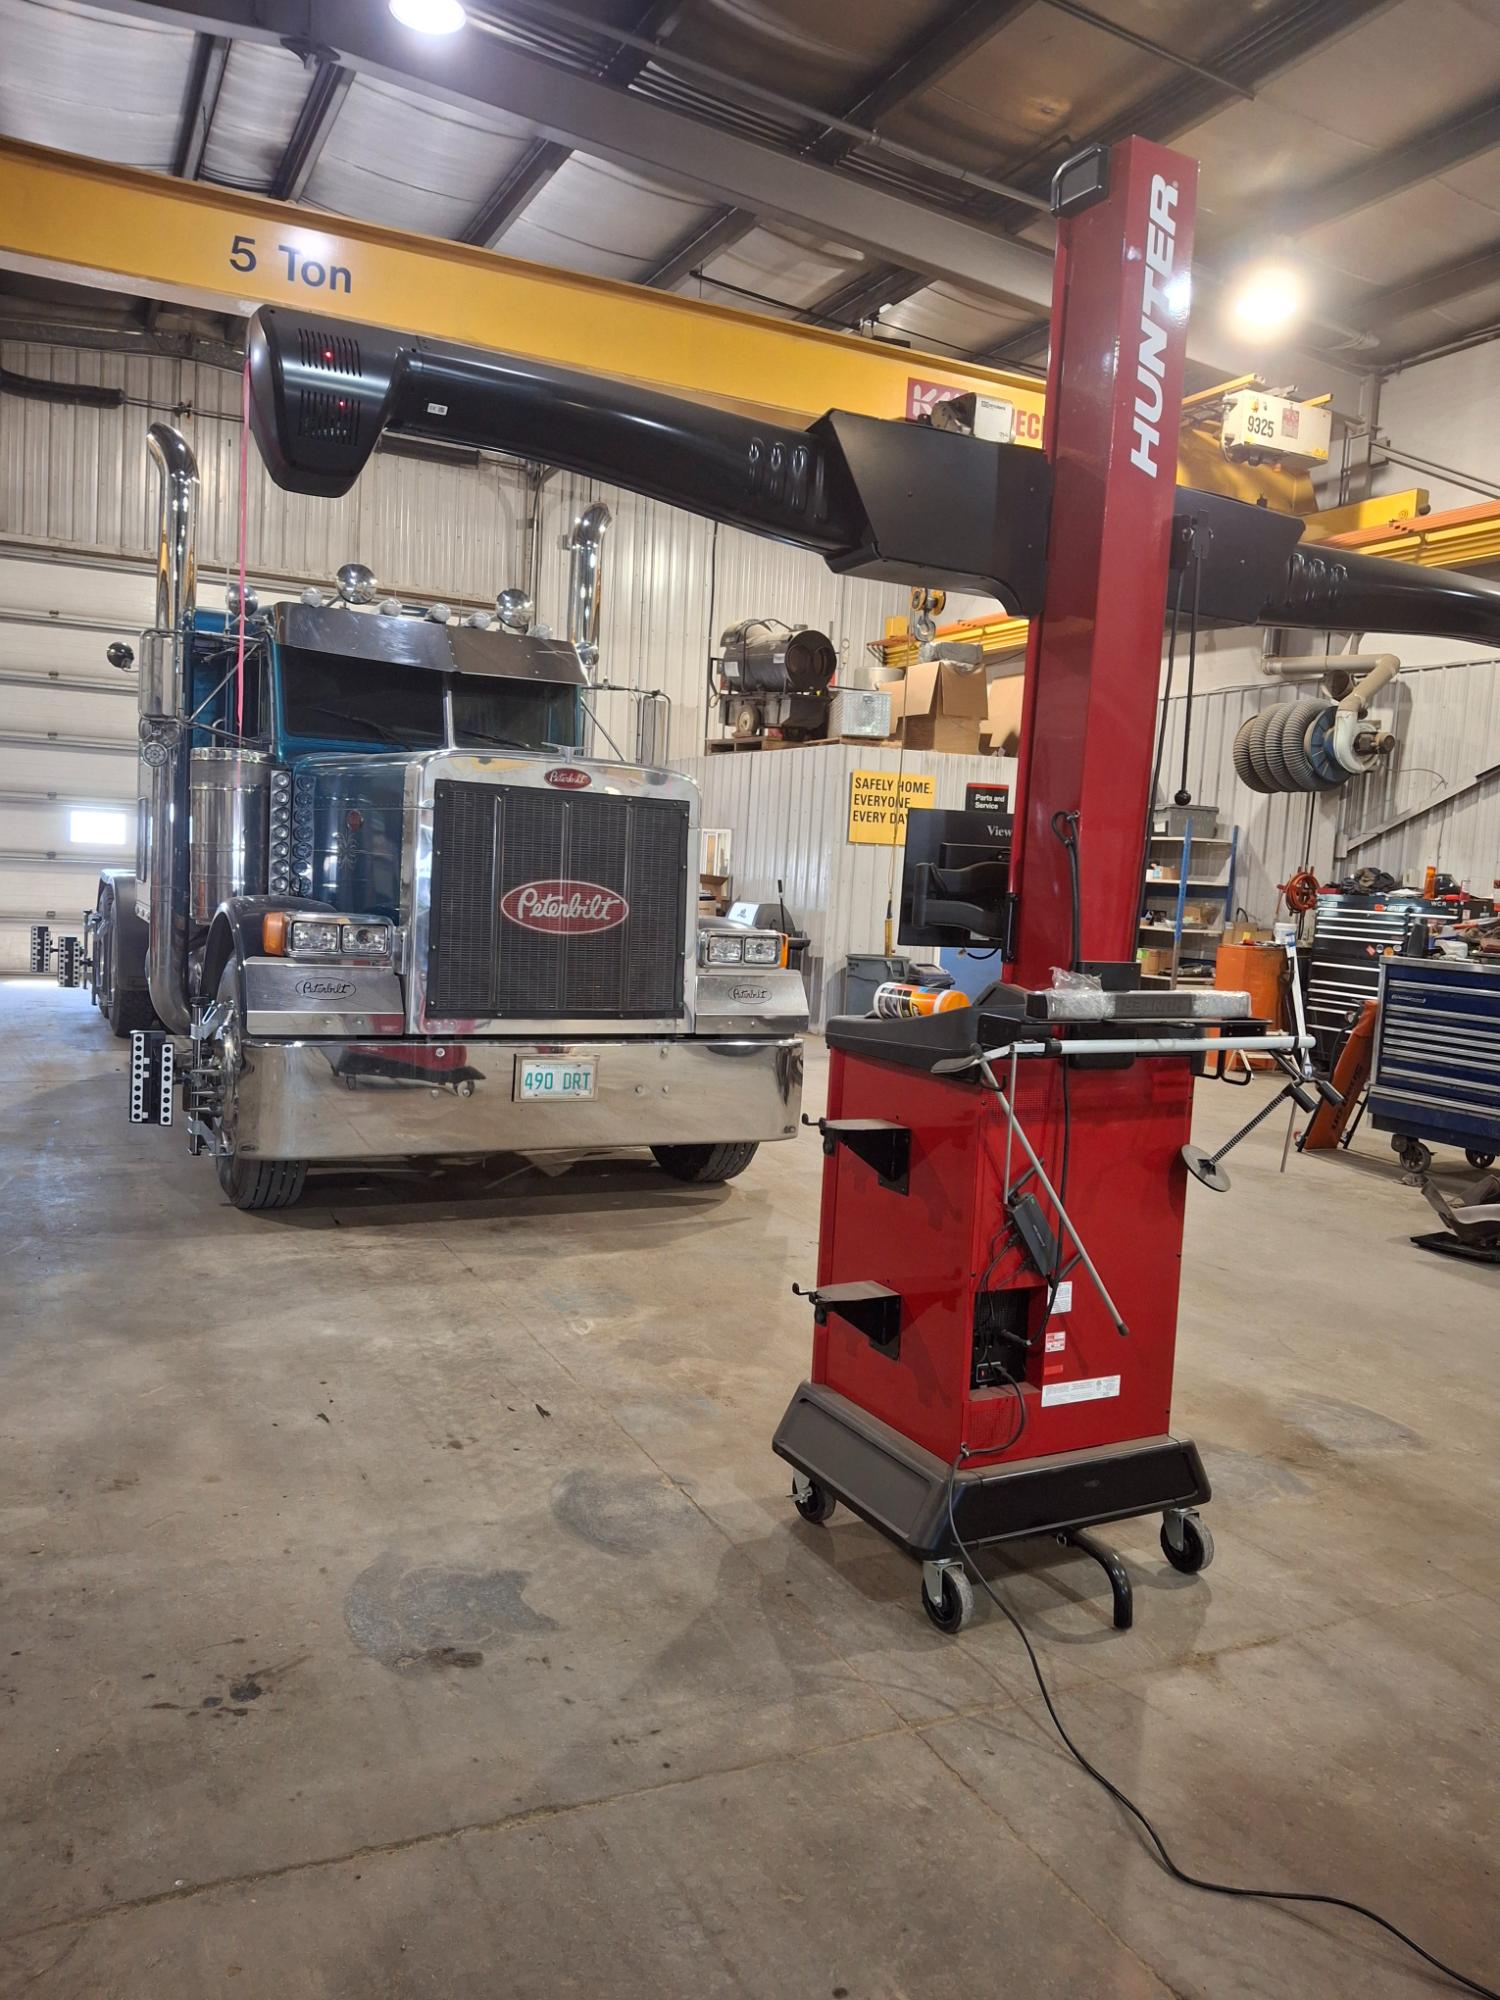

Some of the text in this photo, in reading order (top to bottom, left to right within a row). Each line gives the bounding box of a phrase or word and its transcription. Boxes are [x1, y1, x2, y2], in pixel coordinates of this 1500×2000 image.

[229, 235, 352, 293] 5 Ton
[1130, 173, 1178, 478] HUNTER
[1247, 415, 1274, 438] 9325
[549, 770, 589, 784] Peterbilt
[855, 777, 933, 794] SAFELY HOME.
[854, 793, 911, 809] EVERYONE
[974, 801, 999, 809] Service
[975, 793, 992, 801] Parts
[853, 810, 886, 824] EVERY
[517, 887, 620, 920] Peterbilt
[302, 981, 351, 994] Peterbilt
[524, 1072, 591, 1090] 490 DRT
